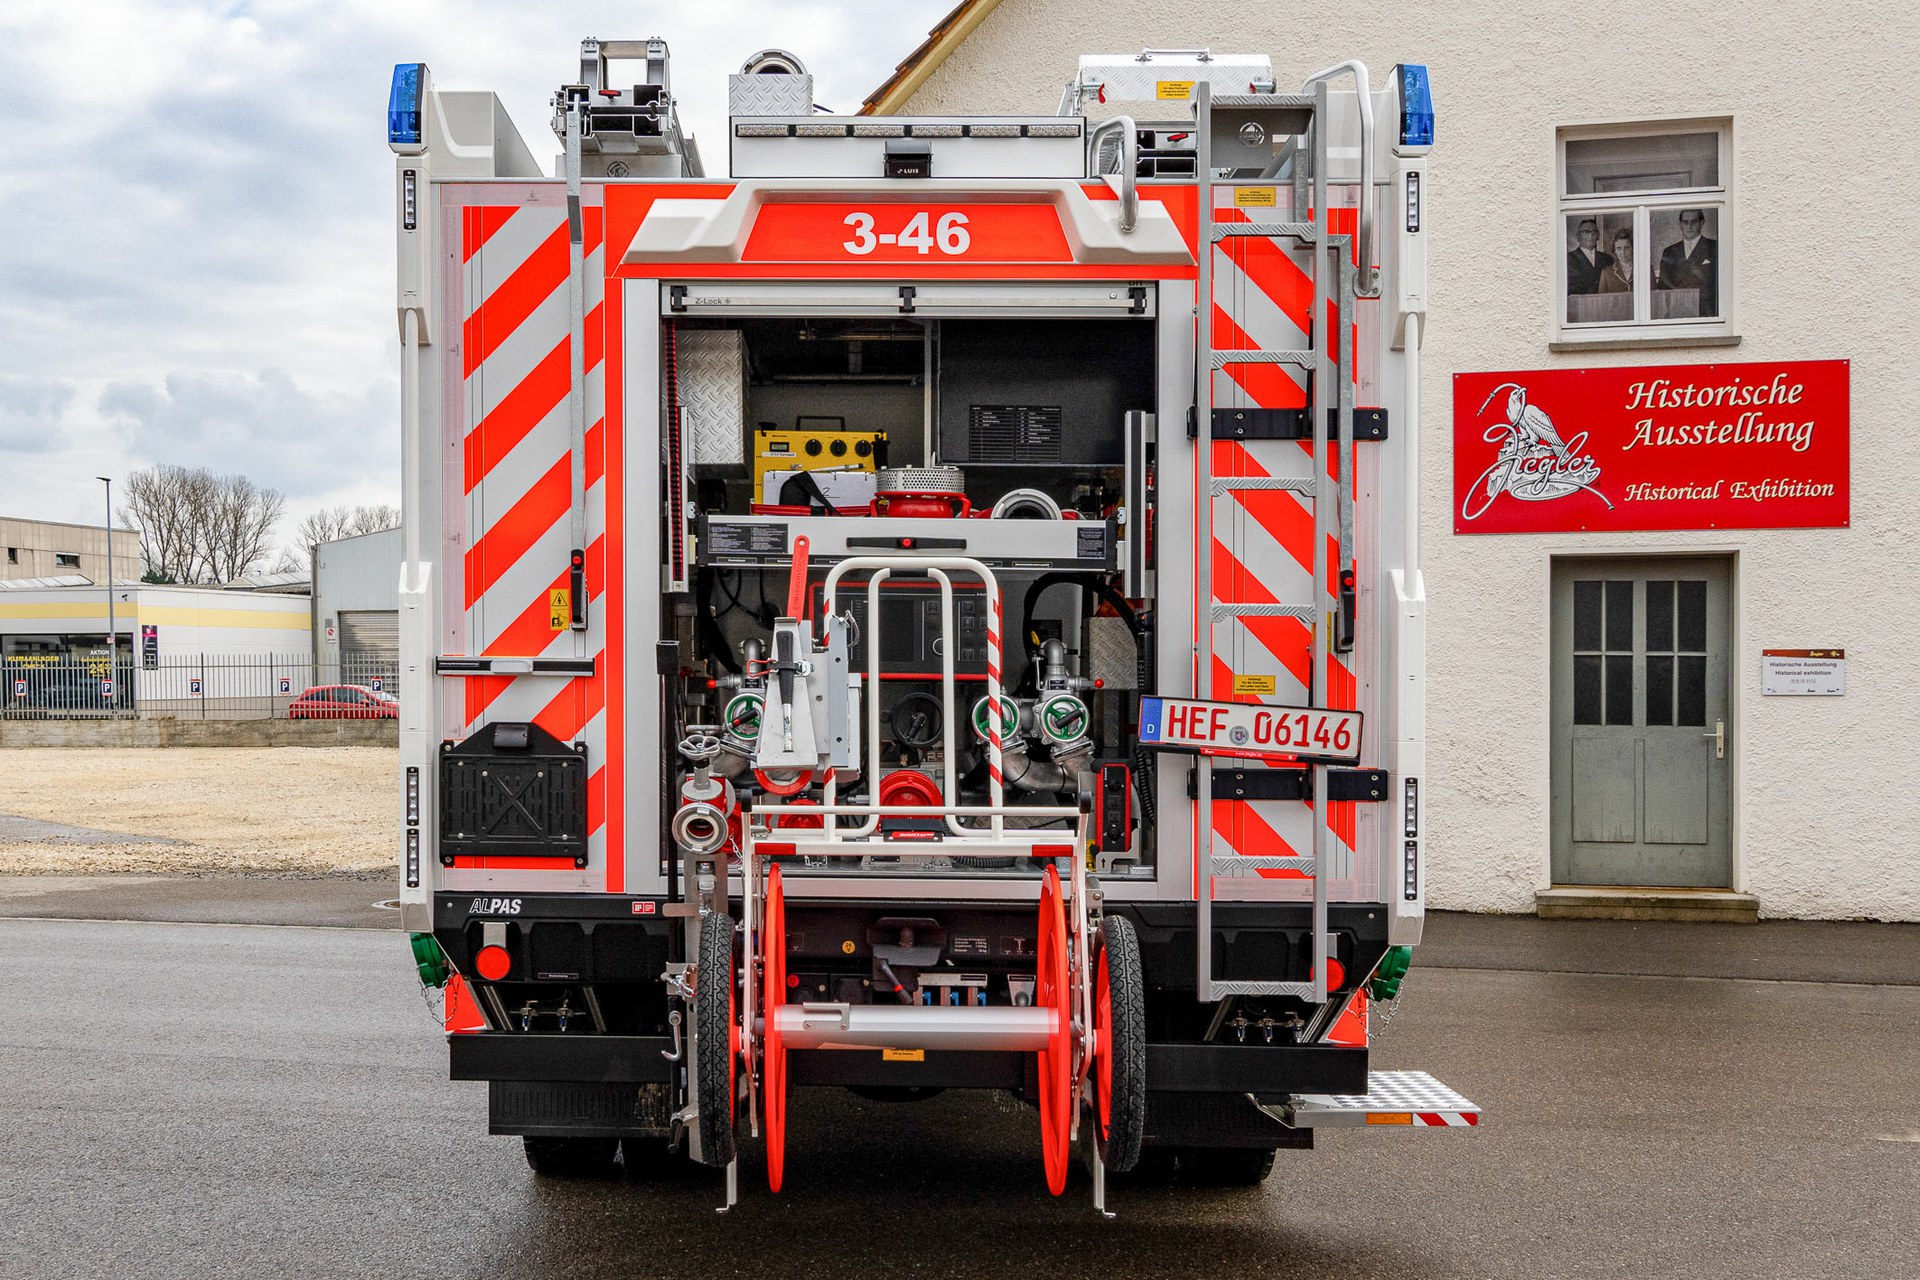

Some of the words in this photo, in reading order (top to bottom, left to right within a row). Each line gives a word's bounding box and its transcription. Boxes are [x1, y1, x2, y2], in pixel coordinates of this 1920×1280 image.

[842, 211, 971, 255] 3-46
[695, 297, 722, 305] Z-Lock
[1625, 373, 1803, 410] Historische
[1622, 412, 1815, 452] Ausstellung
[1624, 480, 1724, 502] Historical
[1730, 477, 1835, 502] Exhibition
[17, 684, 23, 692] P
[104, 684, 110, 692] P
[192, 682, 199, 692] P
[282, 682, 288, 692] P
[373, 681, 380, 690] P
[1146, 723, 1155, 734] D
[1167, 704, 1229, 741] HEF
[1253, 711, 1351, 750] 06146
[469, 898, 522, 914] ALPAS
